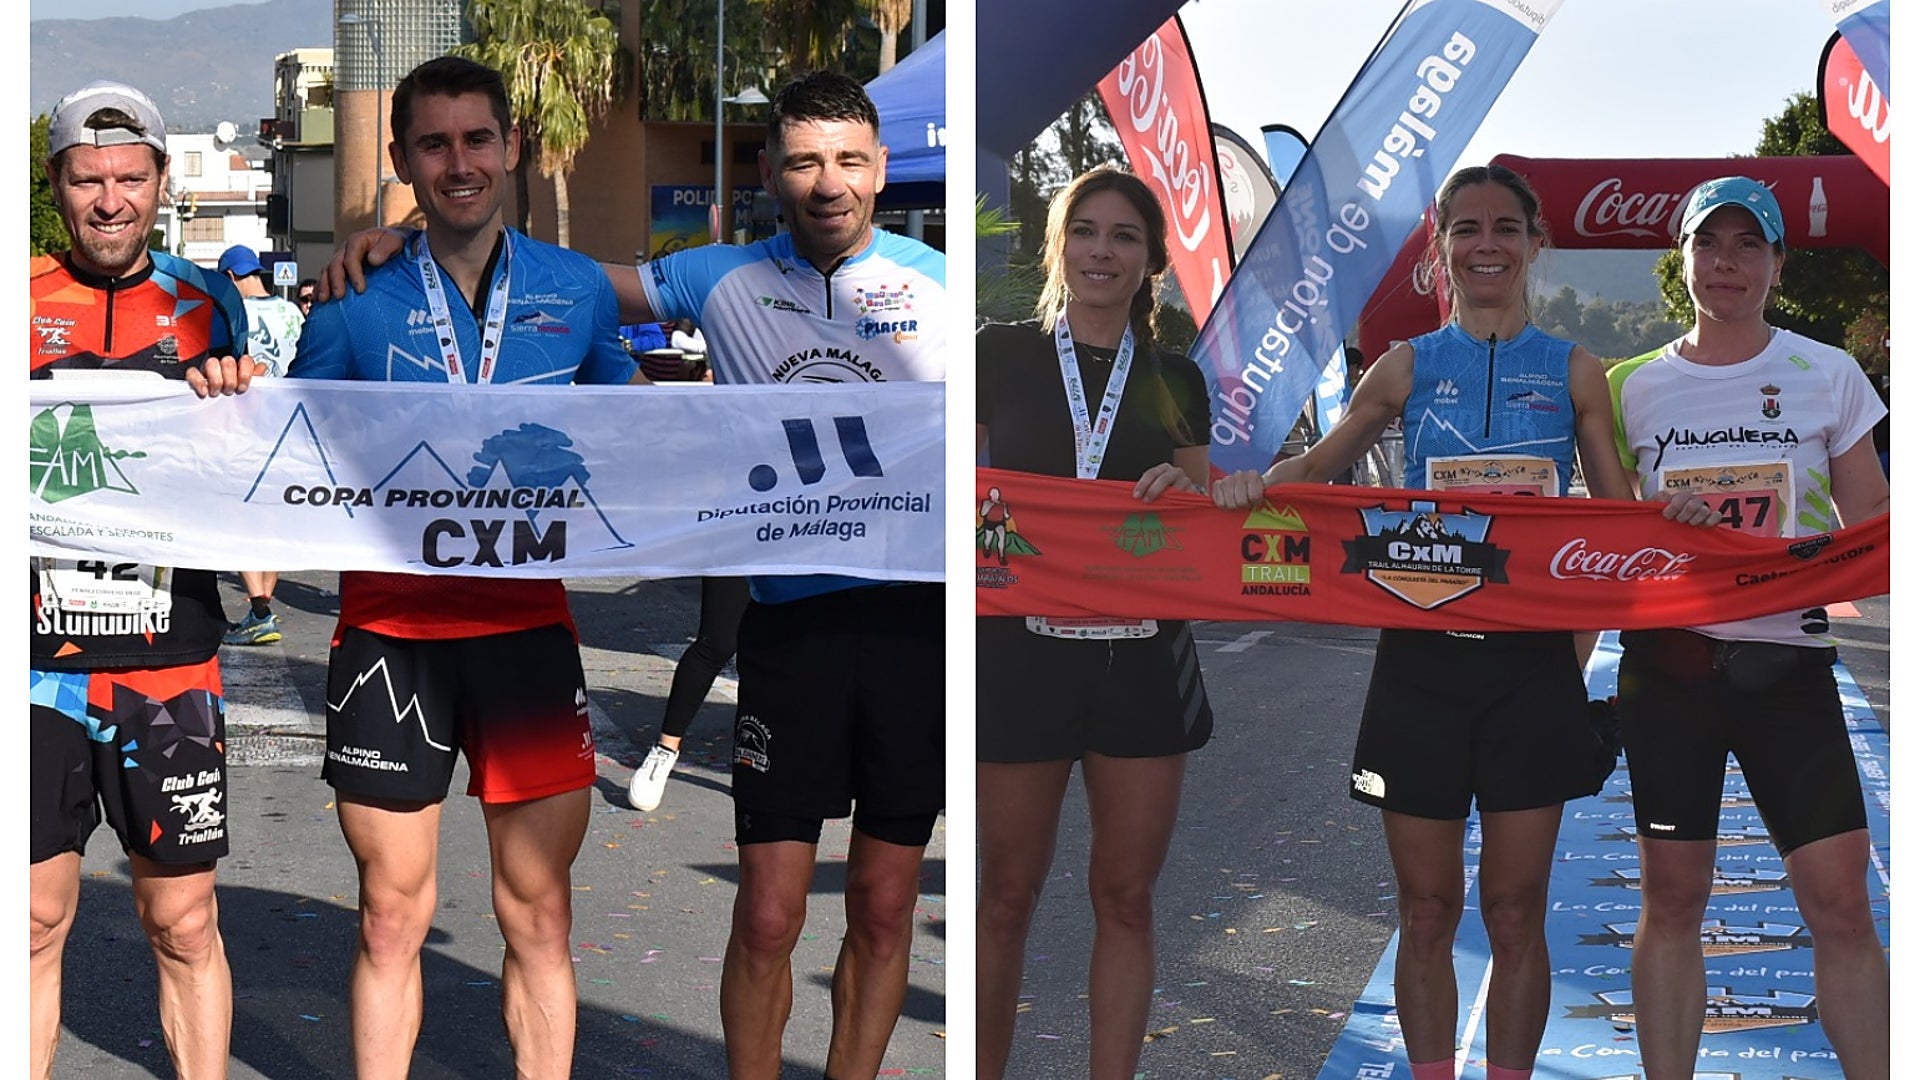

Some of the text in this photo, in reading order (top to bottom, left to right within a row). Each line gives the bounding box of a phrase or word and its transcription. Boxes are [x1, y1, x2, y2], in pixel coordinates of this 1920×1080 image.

[772, 348, 822, 382] NUEVA
[283, 484, 587, 509] COPA PROVINCIAL
[697, 491, 931, 522] Diputación Provincial
[1703, 496, 1771, 530] 47
[756, 518, 866, 542] de Málaga
[421, 517, 567, 569] CXM
[1241, 533, 1311, 563] CXM
[1387, 540, 1463, 564] CxM
[77, 559, 140, 582] 42
[1247, 565, 1306, 582] TRAIL
[328, 750, 409, 772] ENALMÁDENA
[342, 745, 381, 759] ALPINO
[161, 774, 195, 793] Club
[1737, 1046, 1781, 1059] del
